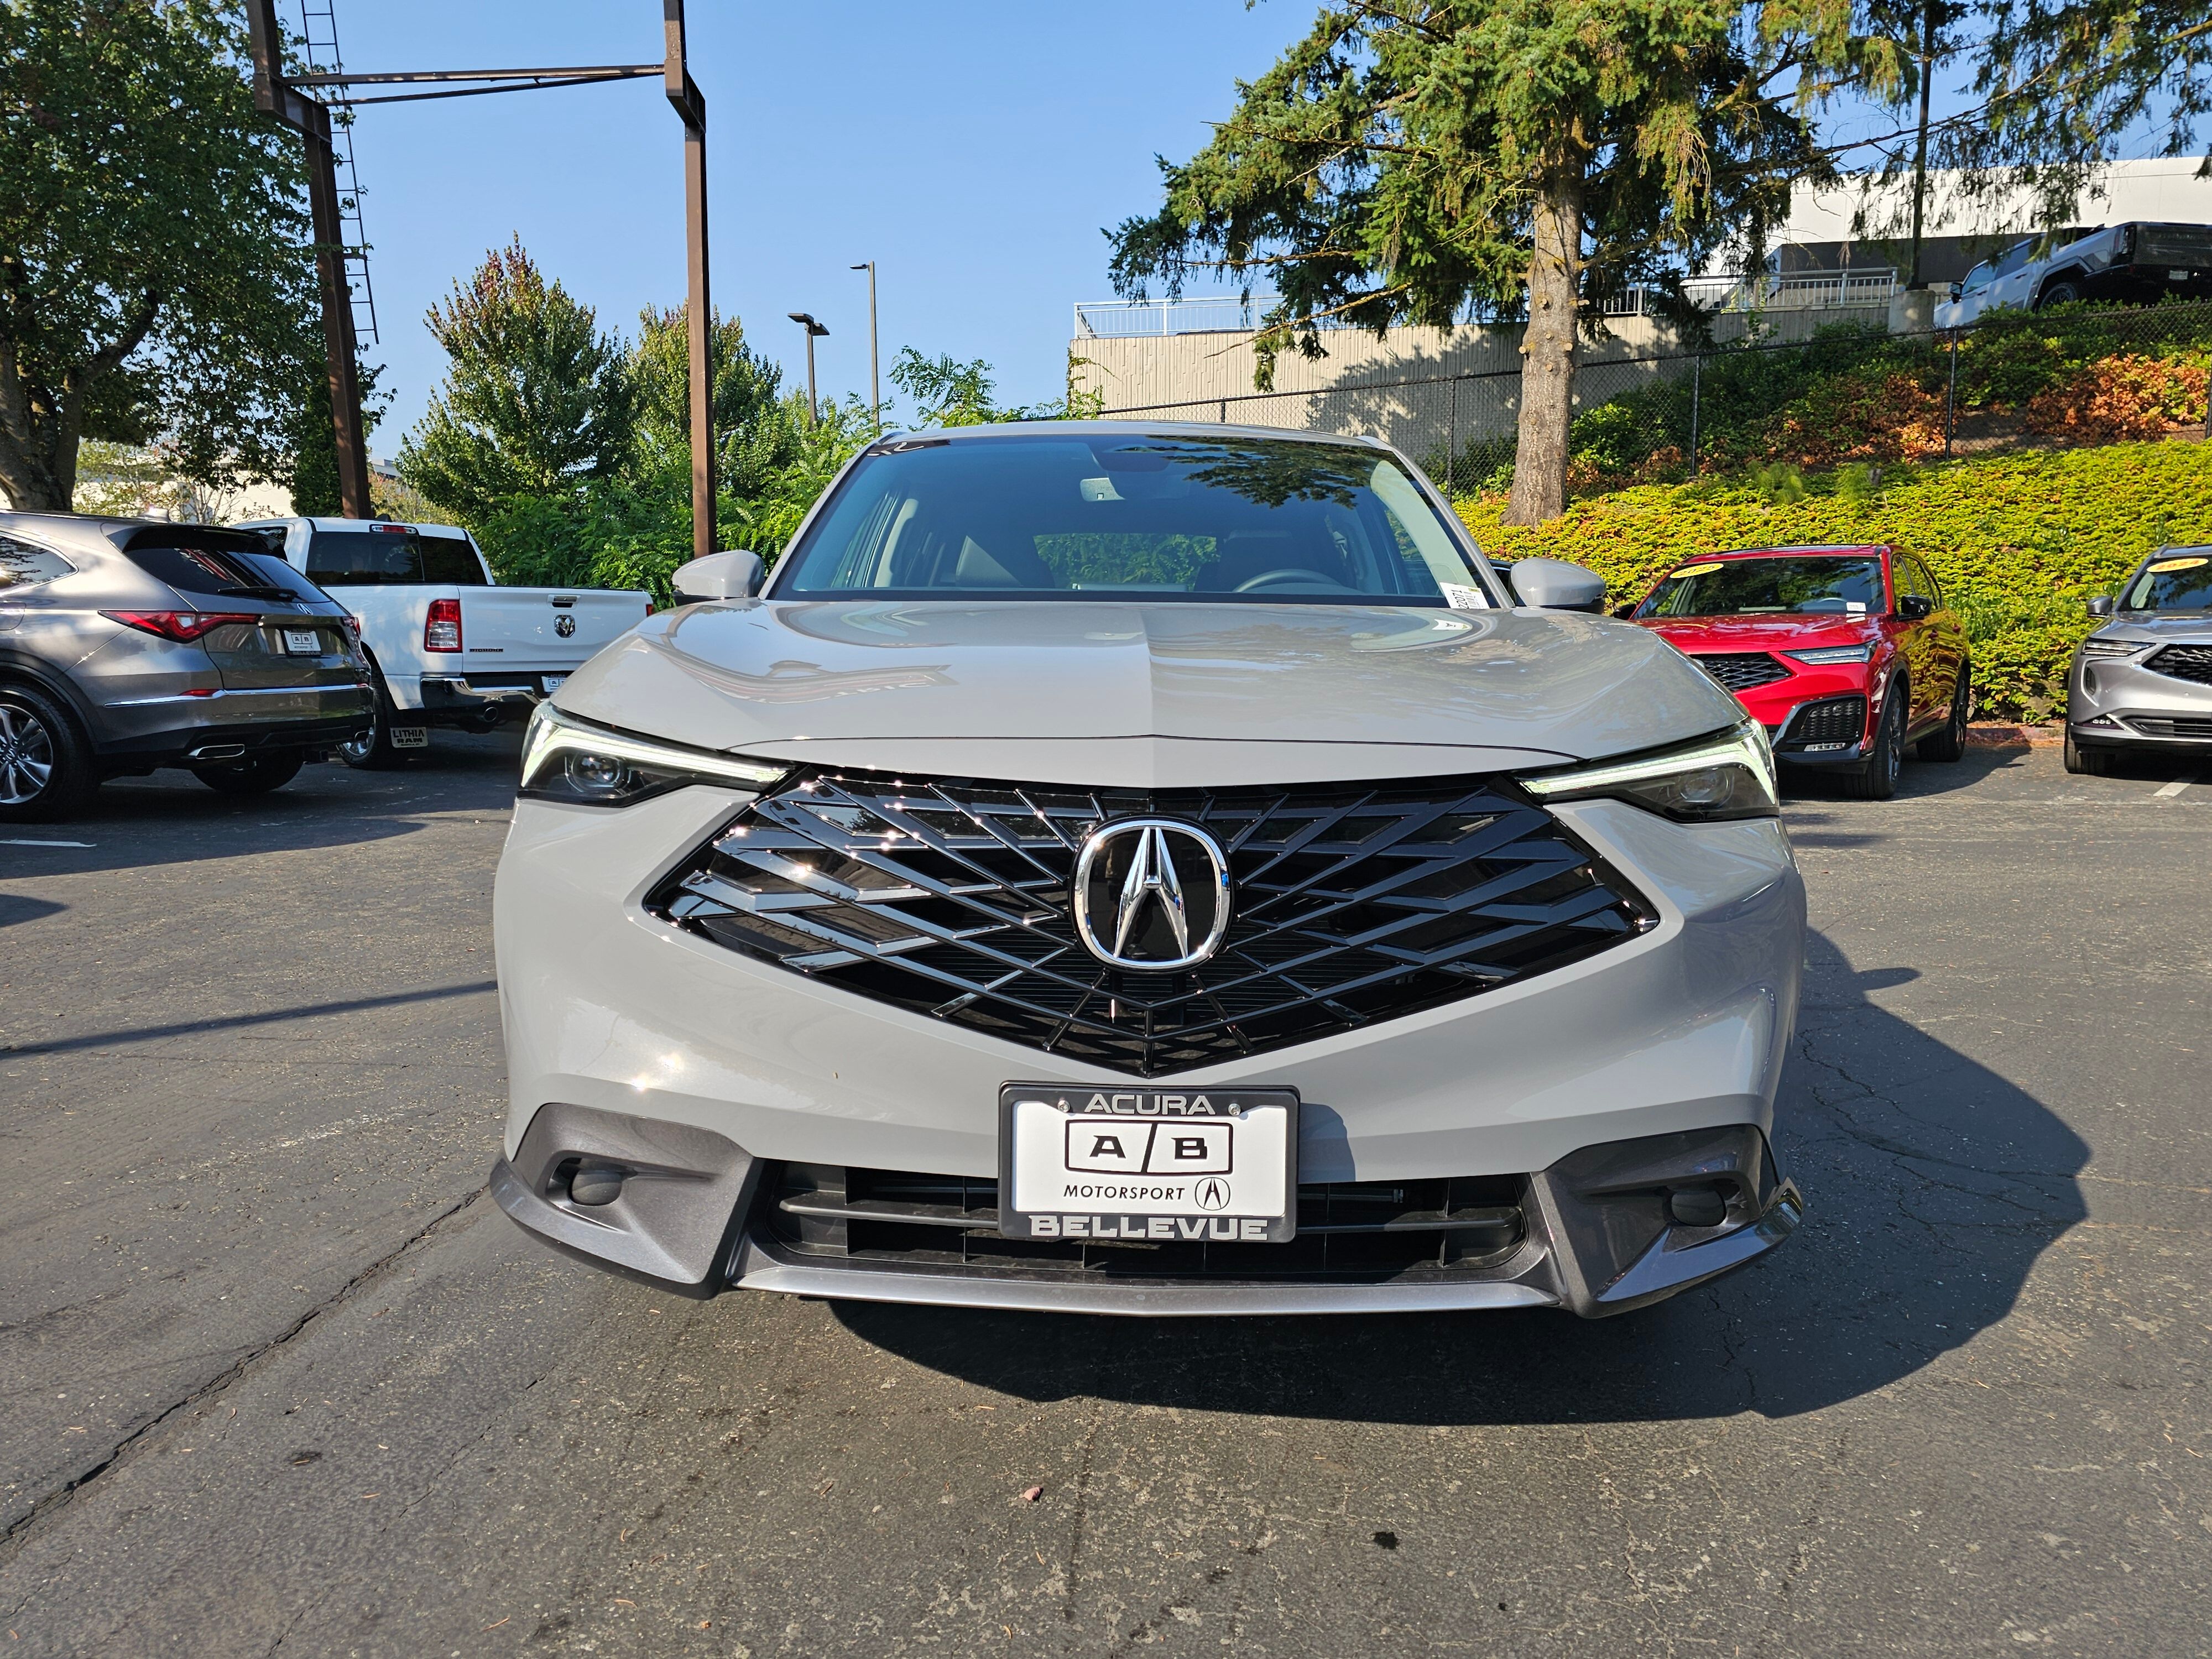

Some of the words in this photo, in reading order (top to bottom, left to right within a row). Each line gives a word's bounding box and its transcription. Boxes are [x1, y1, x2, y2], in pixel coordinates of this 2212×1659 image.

[393, 729, 425, 738] LITHIA
[1084, 1093, 1216, 1116] ACURA
[1089, 1135, 1126, 1159] A
[1171, 1136, 1208, 1160] B
[1063, 1184, 1186, 1201] MOTORSPORT
[1028, 1214, 1268, 1241] BELLEVUE
